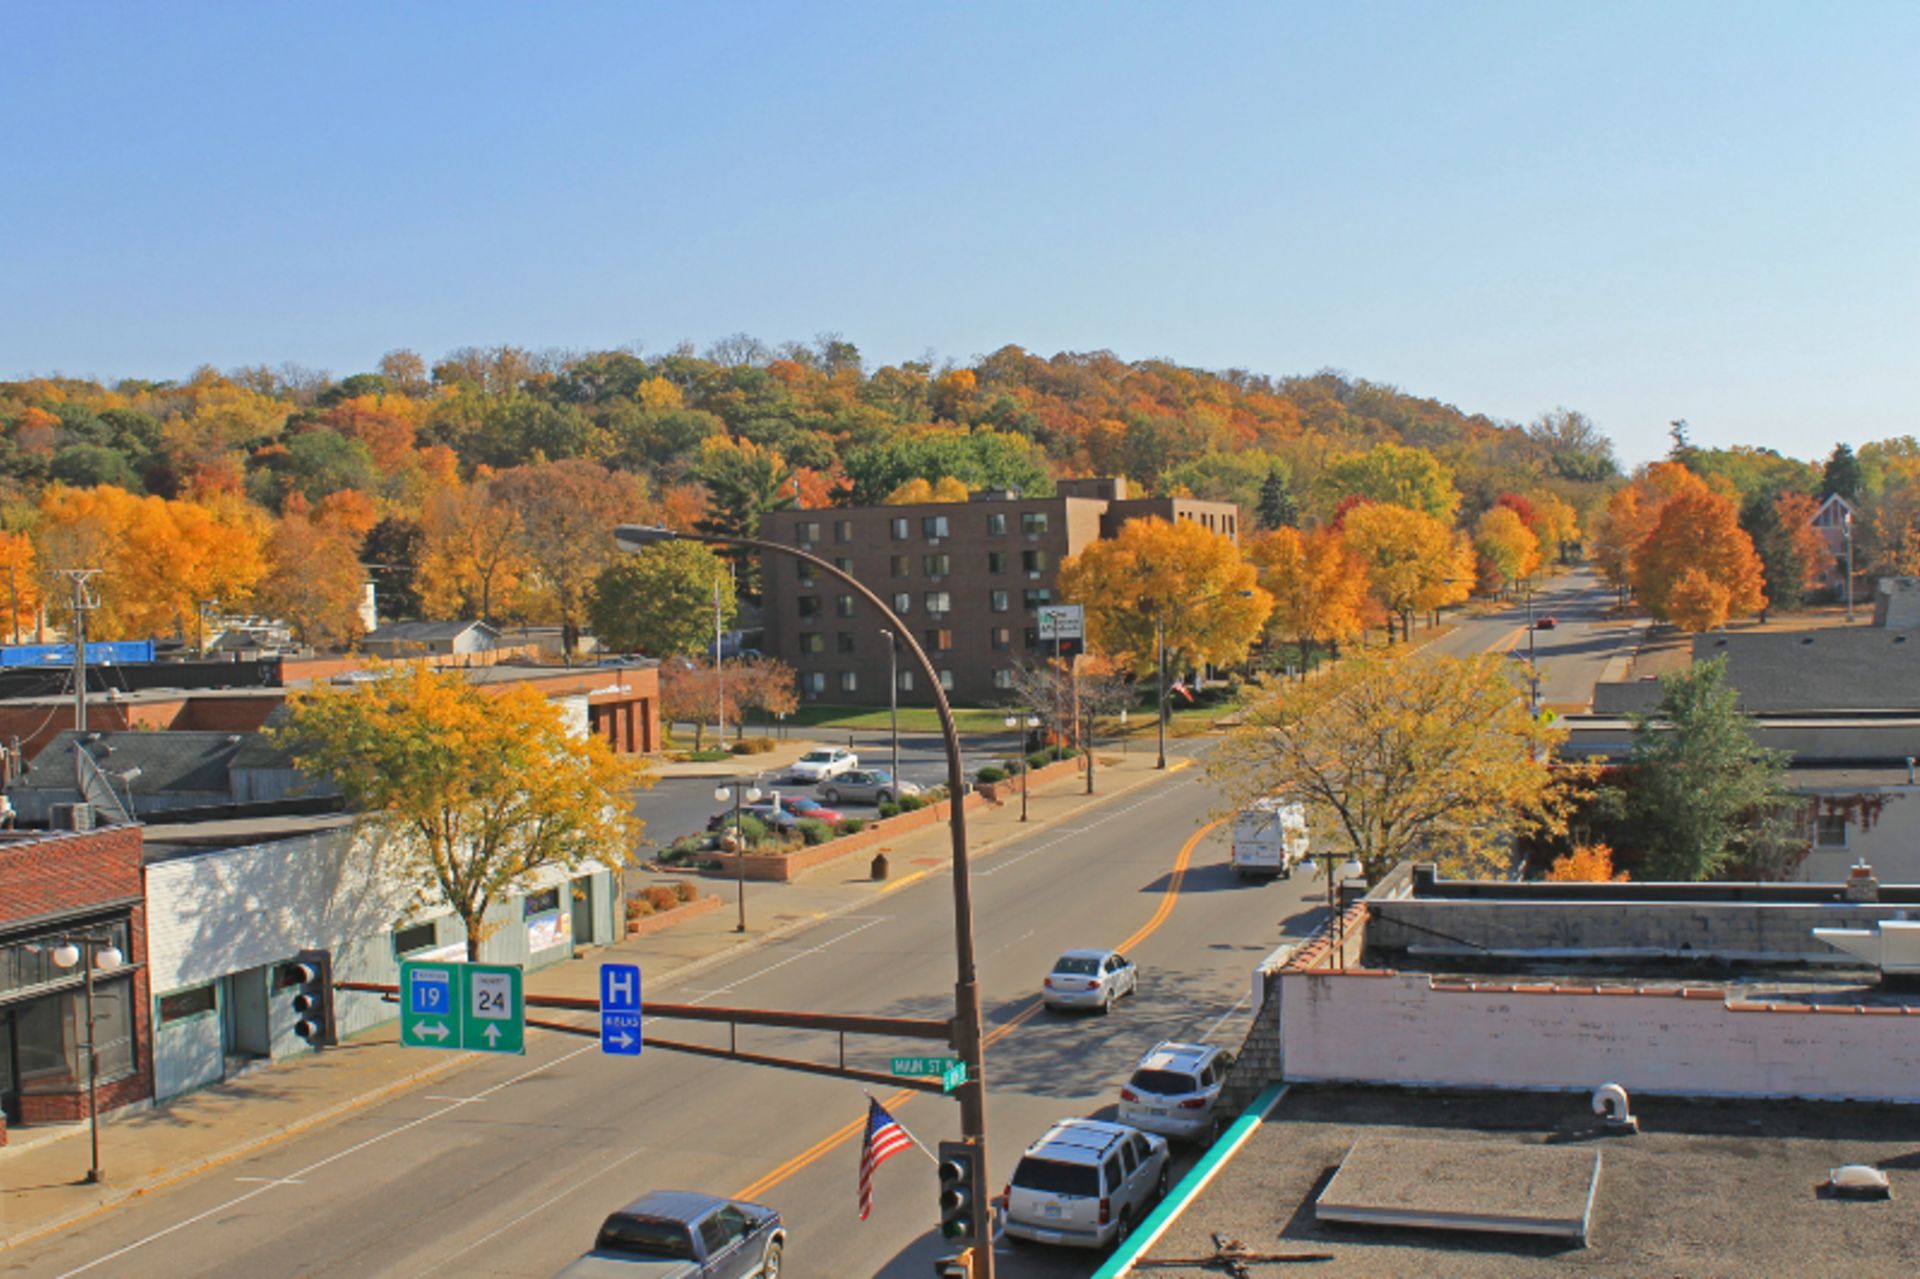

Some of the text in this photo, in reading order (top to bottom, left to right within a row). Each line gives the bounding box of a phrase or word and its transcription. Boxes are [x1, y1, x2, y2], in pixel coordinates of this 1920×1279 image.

[419, 987, 440, 1008] 19
[608, 971, 633, 1005] H
[478, 990, 505, 1012] 24
[929, 1060, 940, 1073] ST
